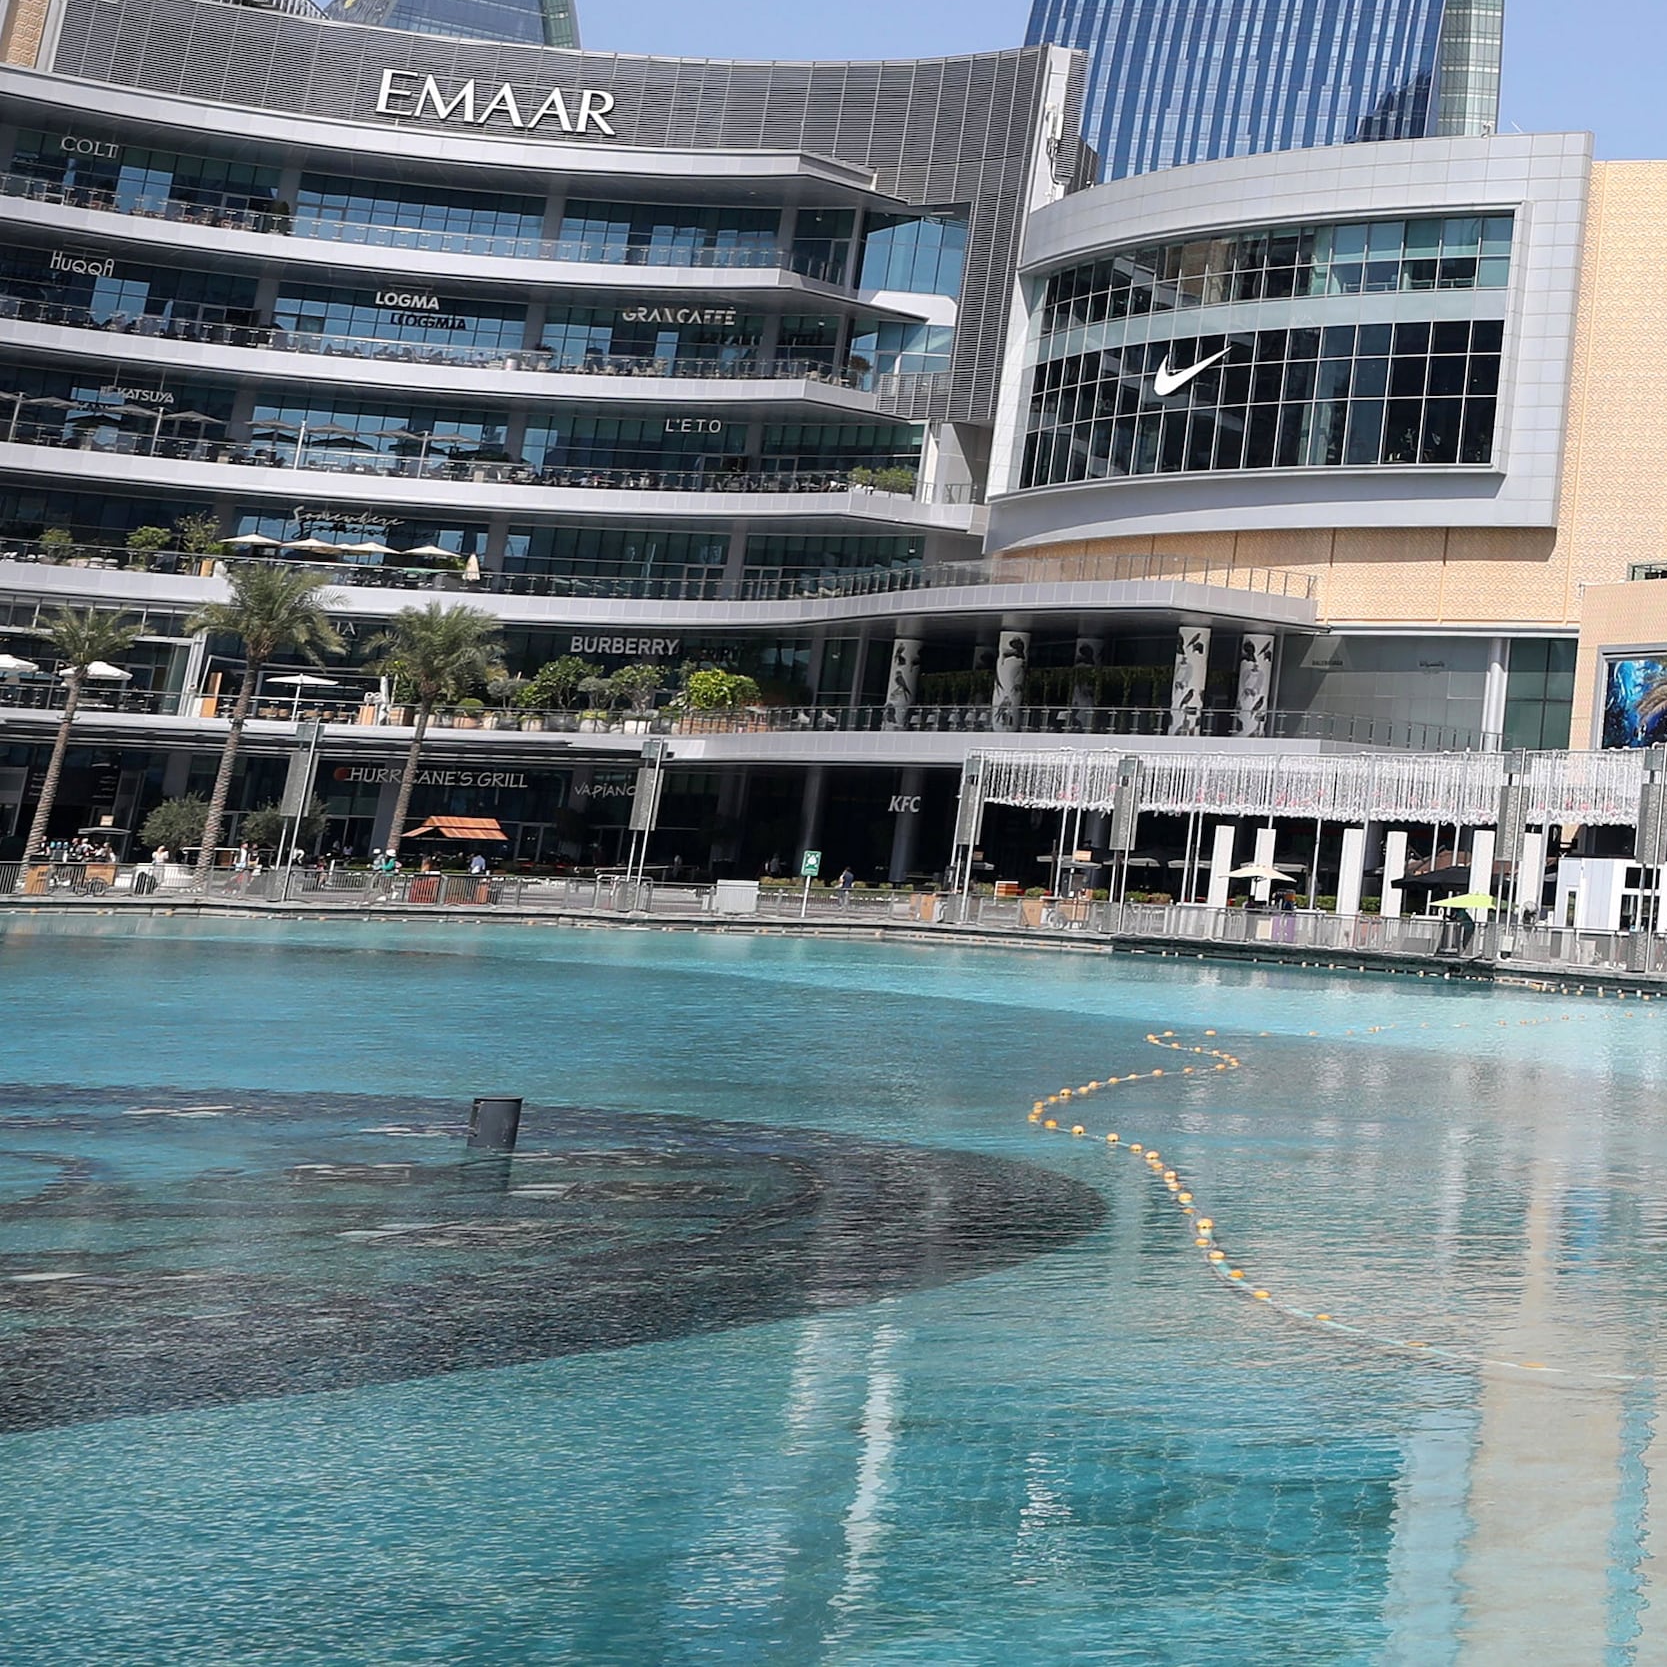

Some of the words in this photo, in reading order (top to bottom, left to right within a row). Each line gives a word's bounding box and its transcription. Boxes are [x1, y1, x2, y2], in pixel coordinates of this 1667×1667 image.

[375, 68, 617, 135] EMAAR
[375, 291, 440, 310] LOGMA
[570, 636, 680, 656] BURBERRY
[349, 767, 474, 787] HURRCANE'S
[477, 772, 528, 788] GRILL
[888, 795, 921, 813] KFC
